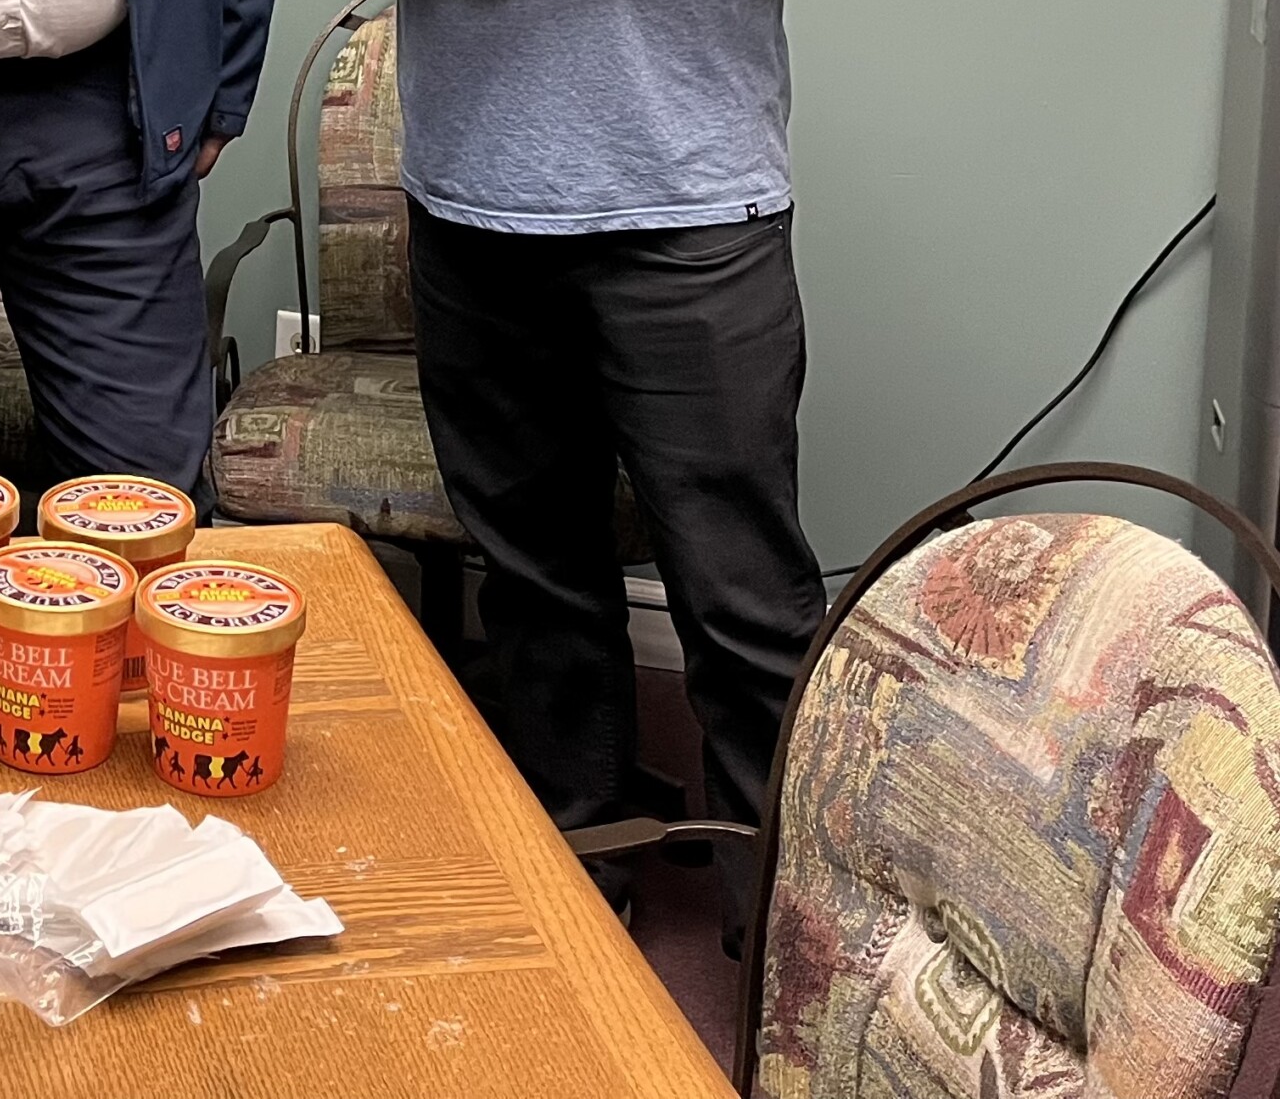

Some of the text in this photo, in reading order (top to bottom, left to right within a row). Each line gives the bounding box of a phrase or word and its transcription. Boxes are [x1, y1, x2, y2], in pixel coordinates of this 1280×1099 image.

[108, 512, 175, 533] CREAM
[210, 604, 284, 627] CREAM
[10, 642, 74, 667] BELL
[192, 667, 258, 690] BELL
[167, 681, 256, 712] CREAM
[158, 701, 224, 731] BANANA
[164, 720, 215, 745] FUDGE
